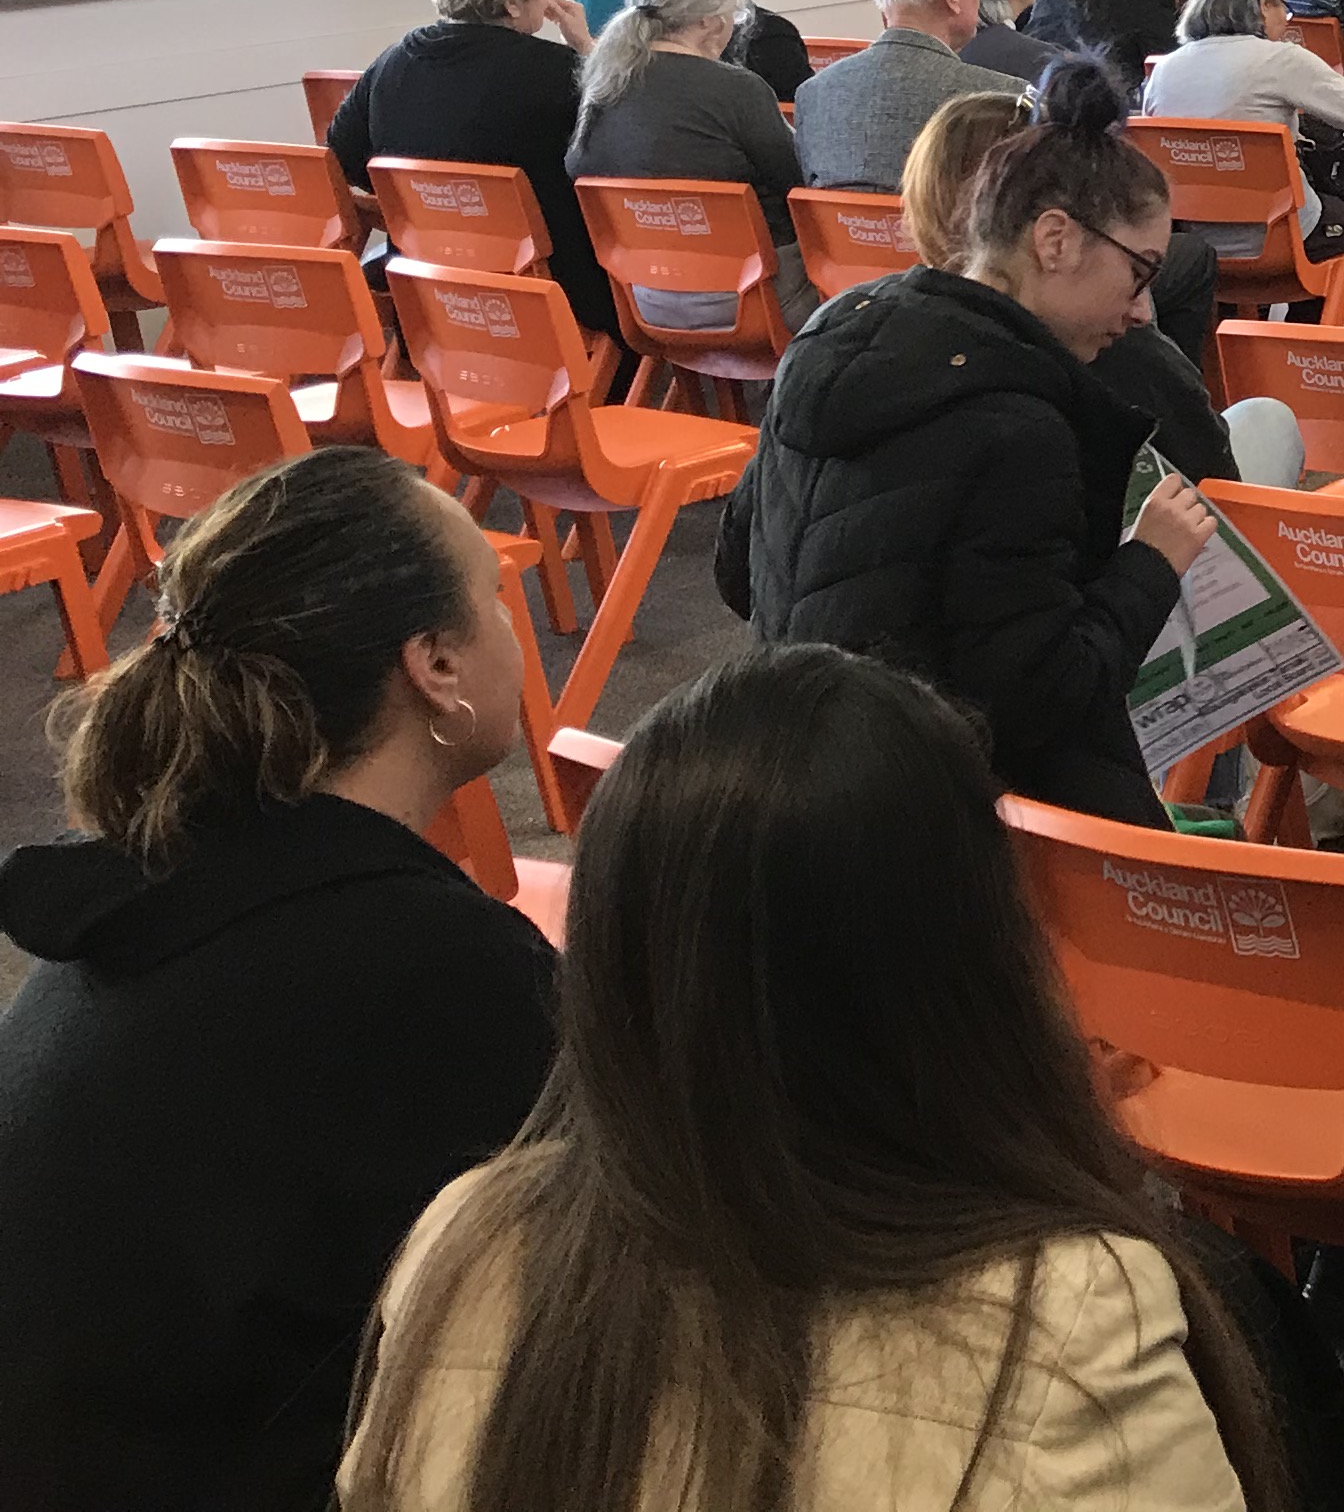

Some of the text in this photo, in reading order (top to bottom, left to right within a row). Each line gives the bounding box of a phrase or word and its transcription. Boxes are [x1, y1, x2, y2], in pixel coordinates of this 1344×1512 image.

[1161, 137, 1210, 149] Auckland
[1170, 149, 1213, 162] Council
[216, 159, 260, 174] Auckland
[226, 171, 264, 186] Council
[411, 179, 453, 195] Auckland
[420, 192, 457, 207] Council
[624, 198, 673, 214] Auckland
[634, 210, 677, 226] Council
[837, 213, 887, 229] Auckland
[849, 227, 891, 243] Council
[209, 266, 264, 283] Auckland
[222, 281, 269, 297] Council
[434, 287, 480, 310] Auckland
[446, 304, 486, 325] Council
[131, 388, 188, 413] Auckland
[145, 406, 192, 429] Council
[1136, 694, 1188, 730] wrap
[1102, 859, 1217, 906] Auckland
[1127, 890, 1223, 933] Council
